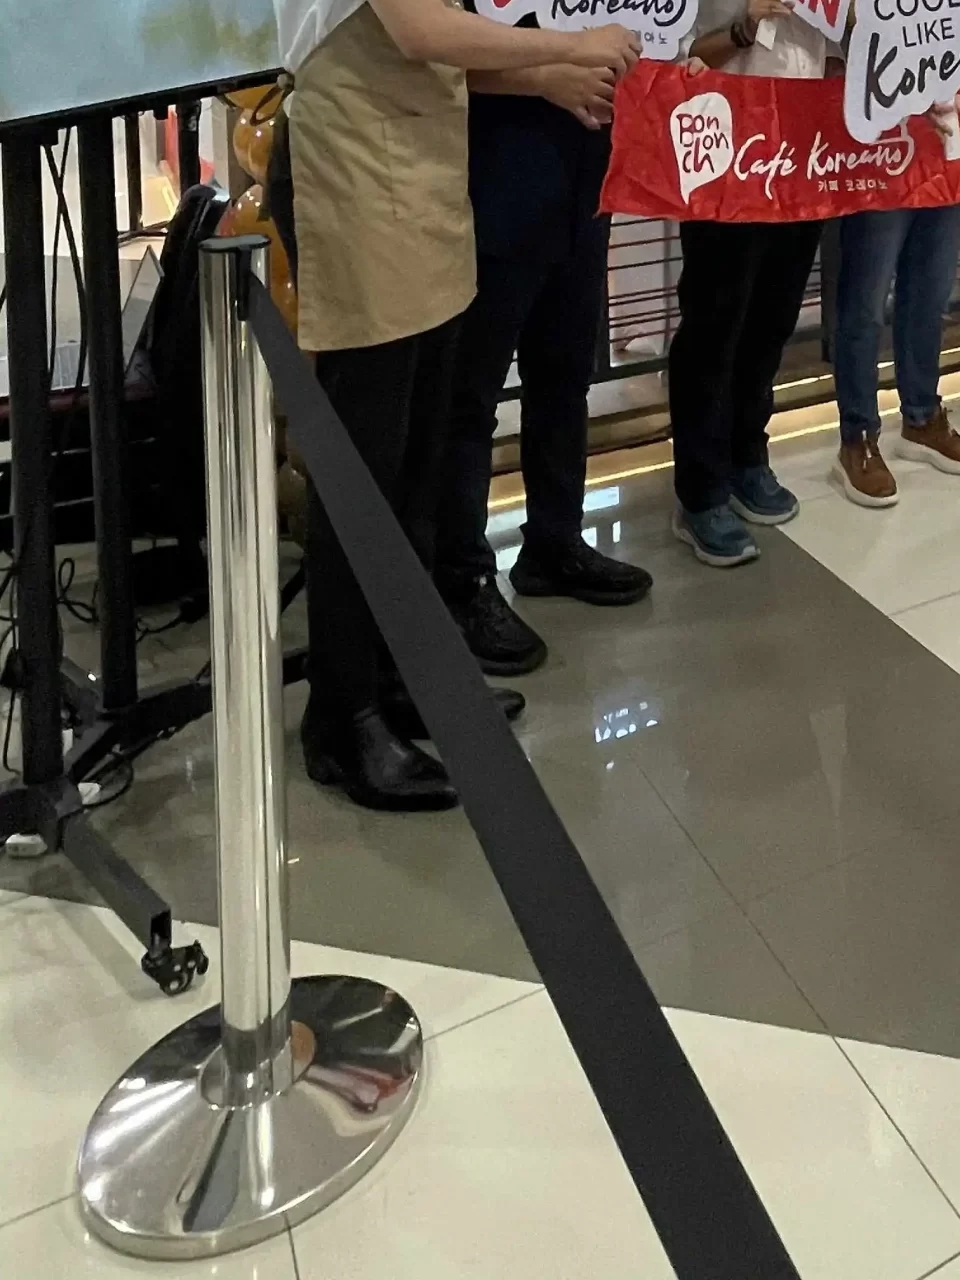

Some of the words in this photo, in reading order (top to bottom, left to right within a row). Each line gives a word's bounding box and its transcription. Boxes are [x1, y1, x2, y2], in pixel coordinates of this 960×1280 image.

[902, 17, 956, 47] LIKE
[734, 133, 797, 200] Café
[807, 130, 902, 179] Koreano
